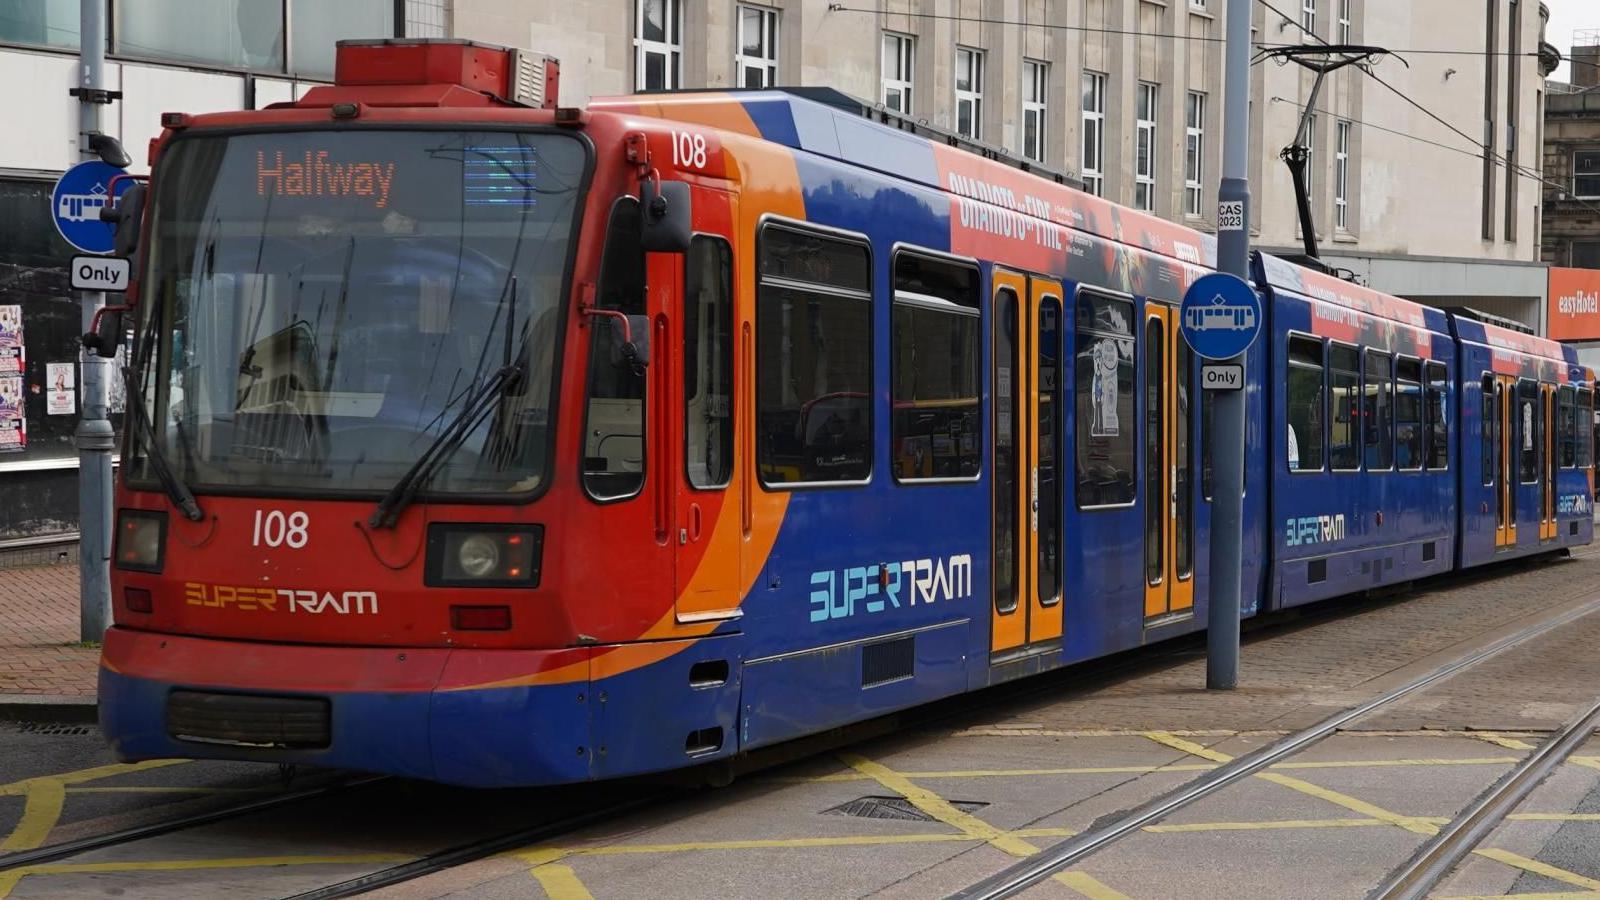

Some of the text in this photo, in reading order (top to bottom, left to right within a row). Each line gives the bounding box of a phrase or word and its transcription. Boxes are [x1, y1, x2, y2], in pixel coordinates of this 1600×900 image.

[671, 130, 707, 169] 108
[257, 150, 395, 208] Halfway
[1219, 204, 1242, 215] CAS
[1219, 216, 1242, 227] 2023
[79, 265, 120, 284] Only
[1559, 290, 1598, 318] easyHotel
[1207, 370, 1236, 385] Only
[252, 509, 310, 549] 108
[1286, 513, 1345, 547] SUPERTRAM
[184, 581, 379, 614] SUPERTRAM
[810, 553, 972, 622] SUPERTRAM
